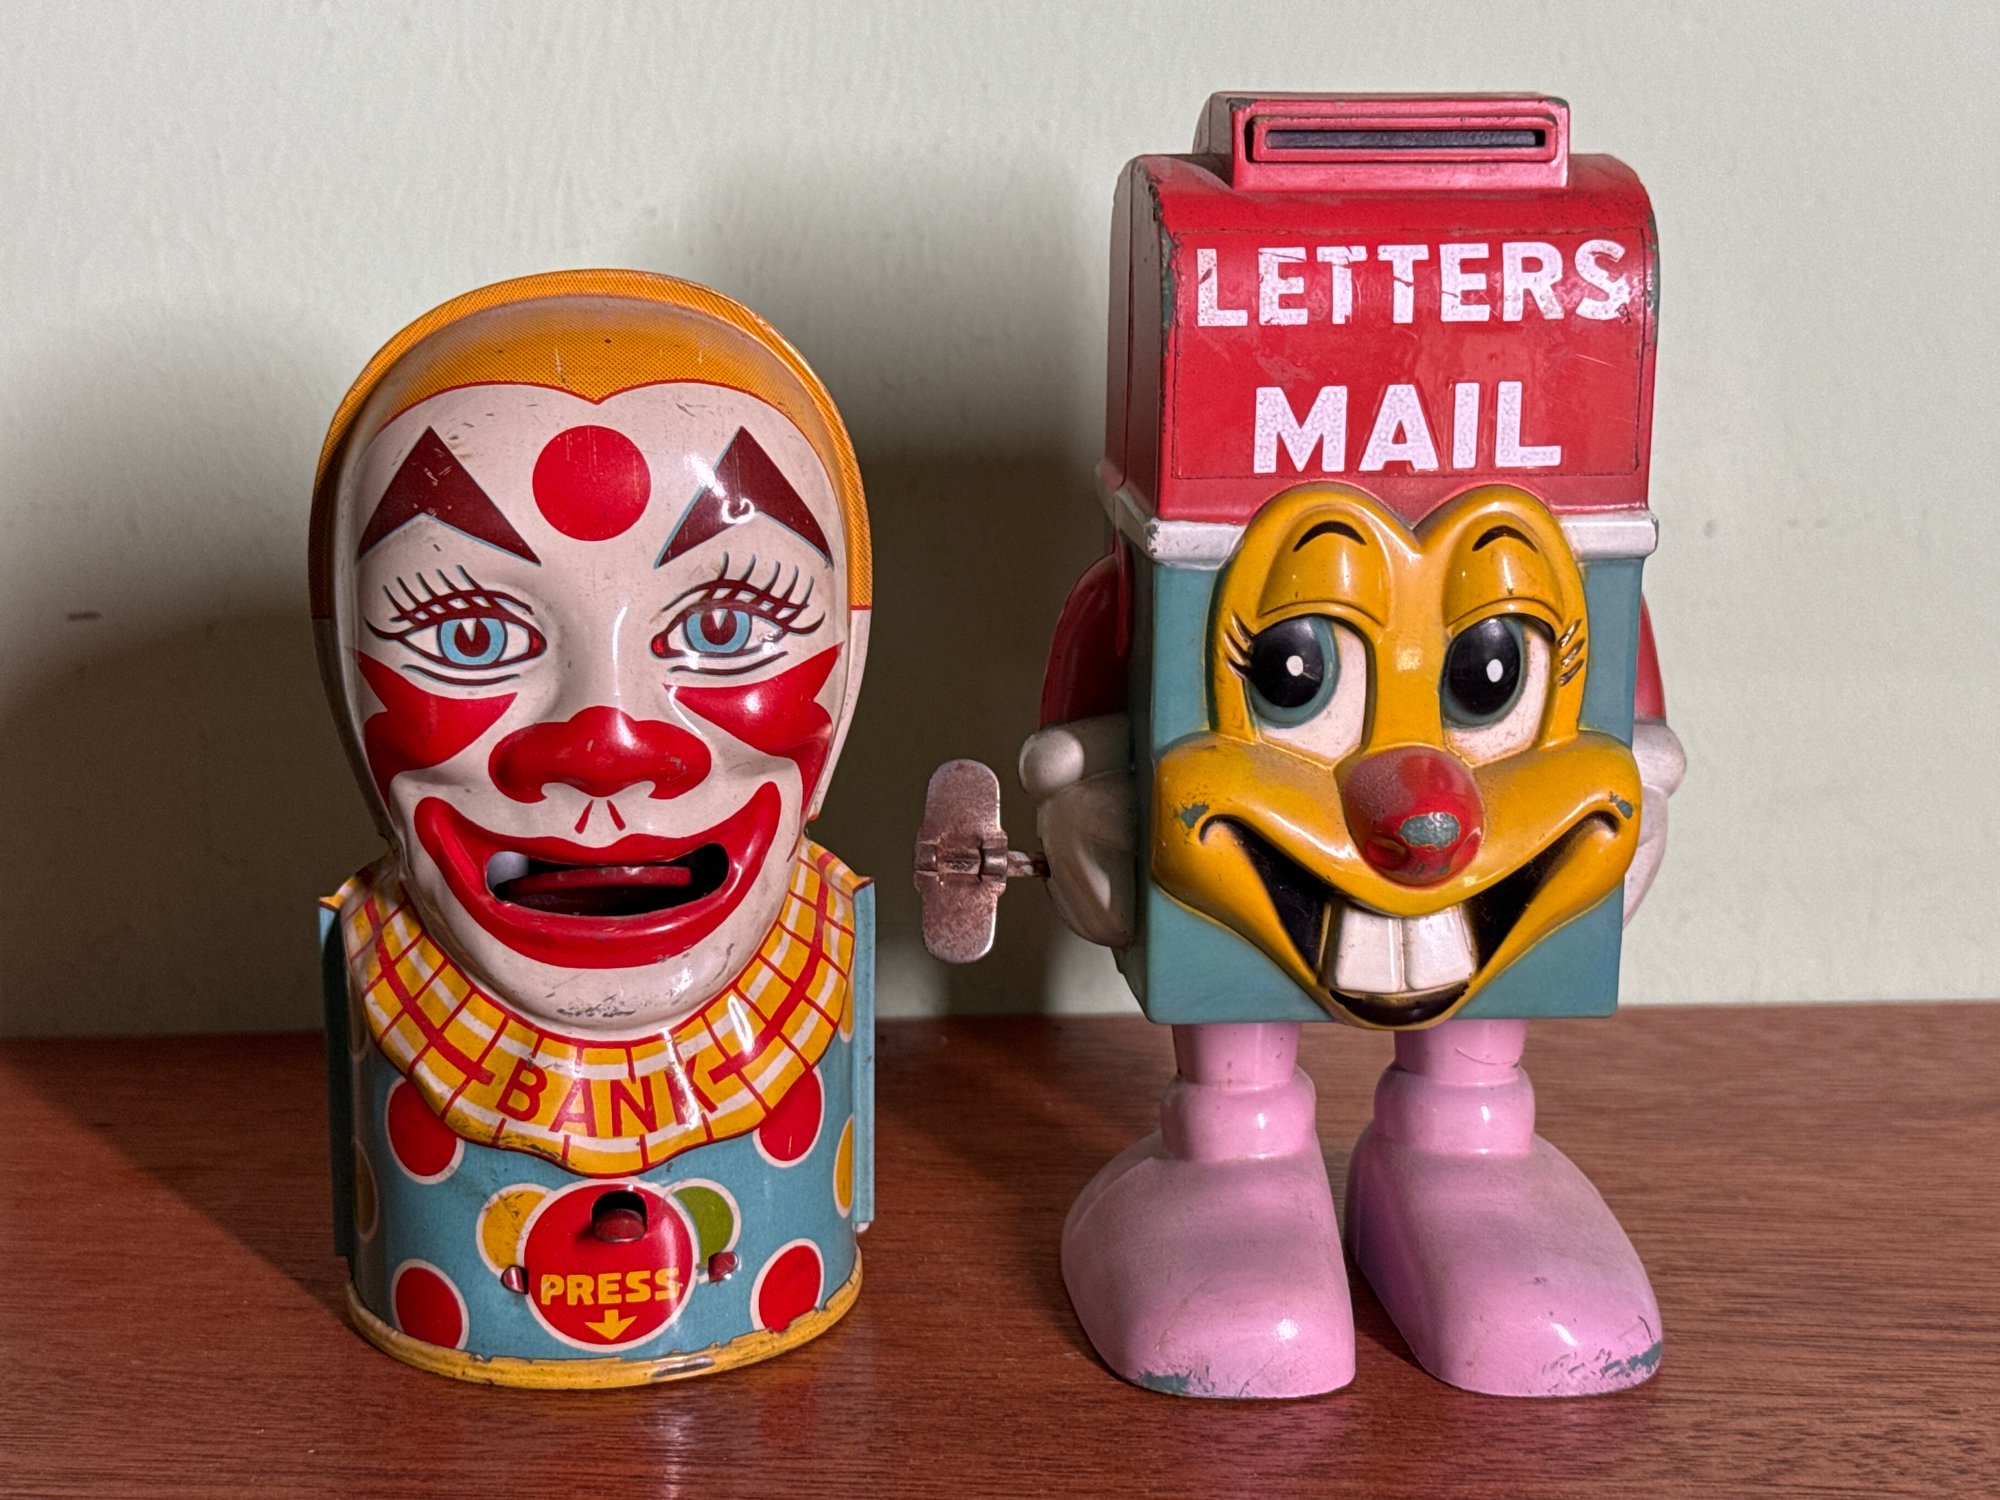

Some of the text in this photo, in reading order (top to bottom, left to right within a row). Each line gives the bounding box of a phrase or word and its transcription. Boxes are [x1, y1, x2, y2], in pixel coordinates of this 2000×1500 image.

[1196, 239, 1632, 327] LETTERS
[1253, 381, 1562, 474] MAIL
[495, 1053, 718, 1138] BANK
[541, 1269, 681, 1305] PRESS
